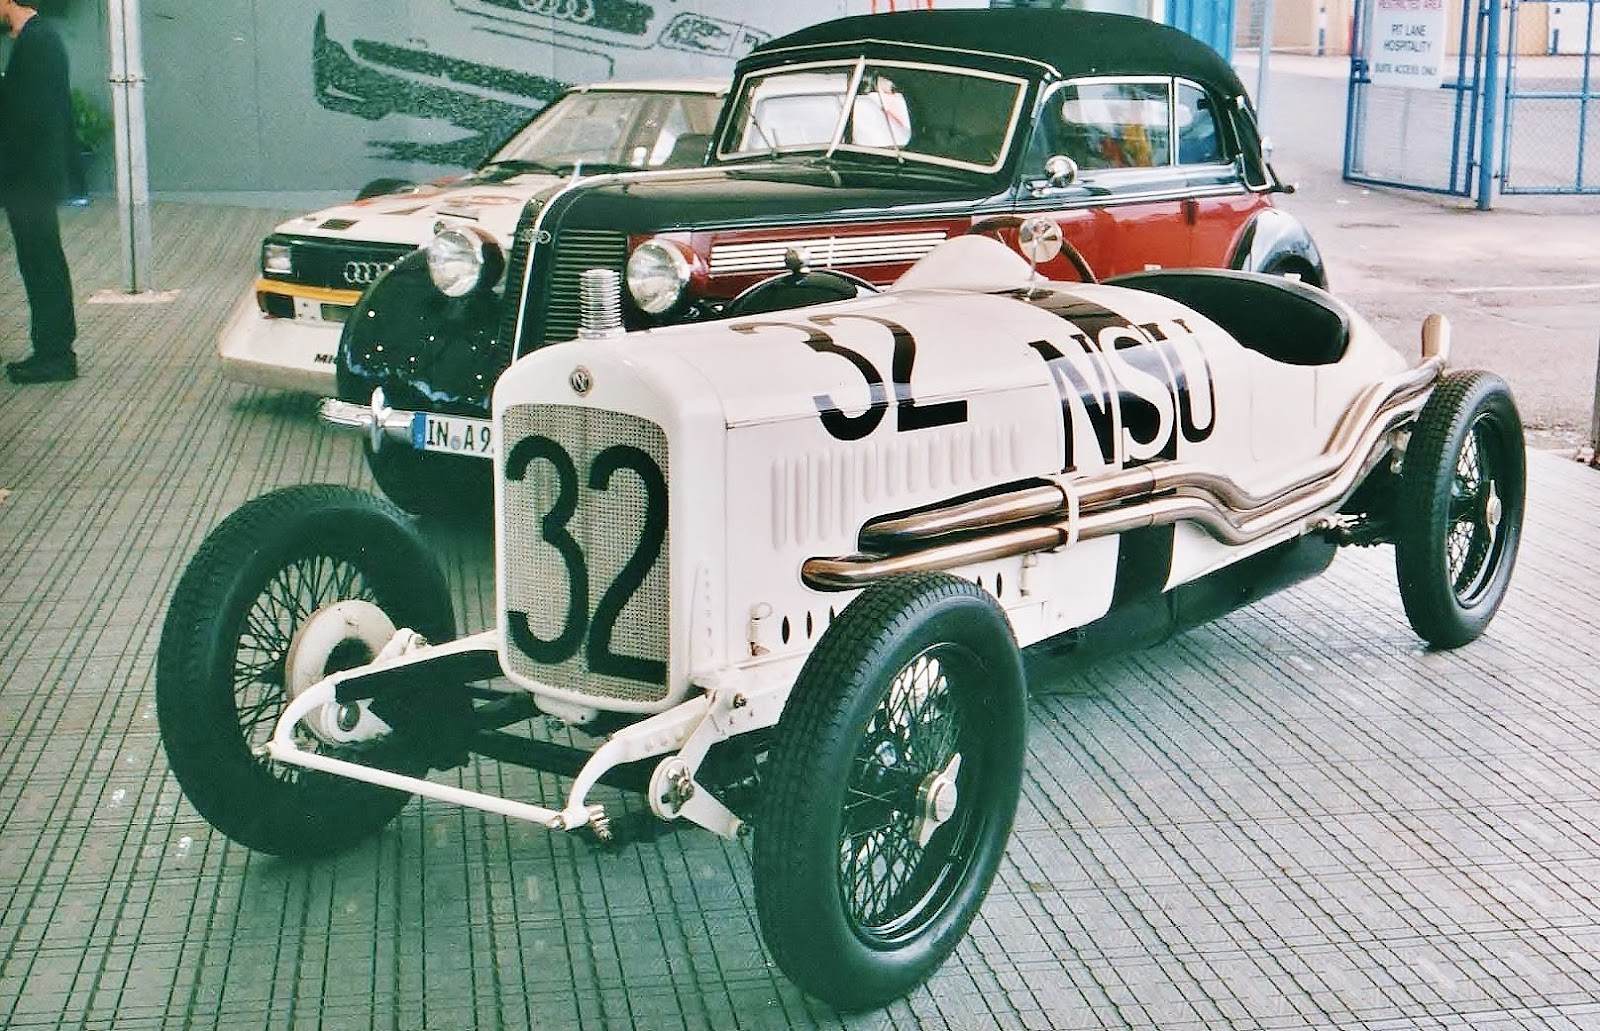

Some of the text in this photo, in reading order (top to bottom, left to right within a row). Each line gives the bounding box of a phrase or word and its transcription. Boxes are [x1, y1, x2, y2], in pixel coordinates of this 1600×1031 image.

[1384, 40, 1431, 52] HOSPITALITY
[1392, 24, 1426, 36] PIT LANE
[729, 314, 968, 441] 32
[1028, 318, 1216, 474] NSU
[427, 420, 448, 447] IN
[505, 435, 669, 685] 32
